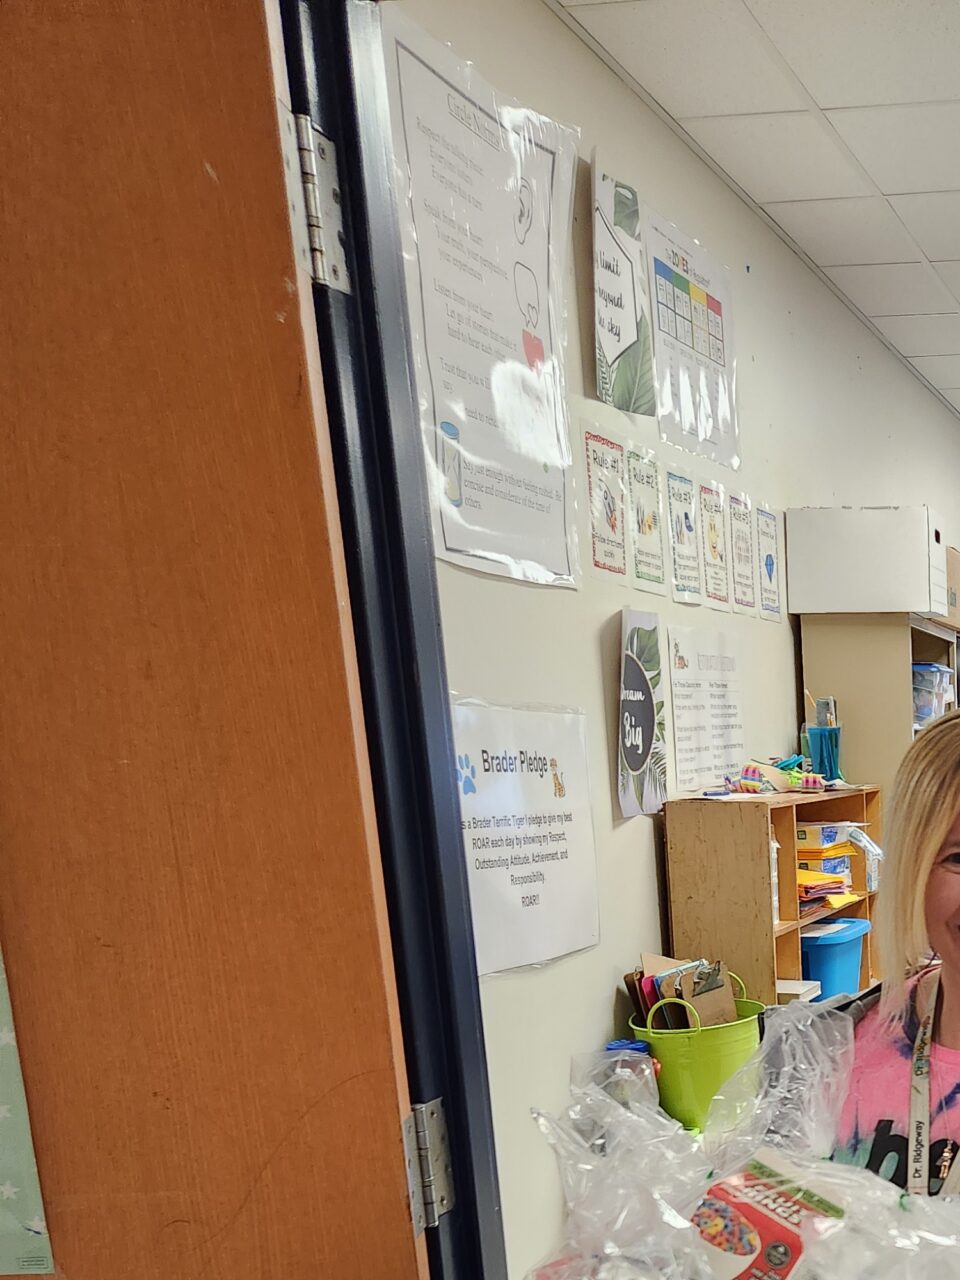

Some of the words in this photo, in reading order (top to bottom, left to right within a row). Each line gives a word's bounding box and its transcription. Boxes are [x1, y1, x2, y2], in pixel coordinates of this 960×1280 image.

[447, 92, 471, 125] Circle
[599, 250, 621, 277] limit
[607, 317, 621, 342] sky
[592, 449, 609, 470] Rule
[610, 457, 619, 474] #1
[633, 467, 645, 485] Rule
[645, 473, 655, 489] #2
[671, 486, 683, 503] Rule
[623, 711, 643, 754] Big
[481, 749, 517, 773] Brader
[519, 750, 548, 779] Pledge
[472, 816, 491, 829] Brader
[492, 815, 511, 828] Terrific
[512, 815, 525, 829] Tiger
[528, 813, 543, 828] pledge
[548, 813, 557, 827] give
[472, 836, 490, 850] ROAR
[490, 836, 505, 848] each
[505, 834, 514, 849] day
[515, 834, 522, 849] by
[523, 832, 543, 847] showing
[475, 856, 510, 870] Outstanding
[560, 849, 568, 860] and
[913, 1120, 925, 1163] Ridgeway
[913, 1163, 922, 1179] Dr.
[741, 1184, 804, 1227] RINGS
